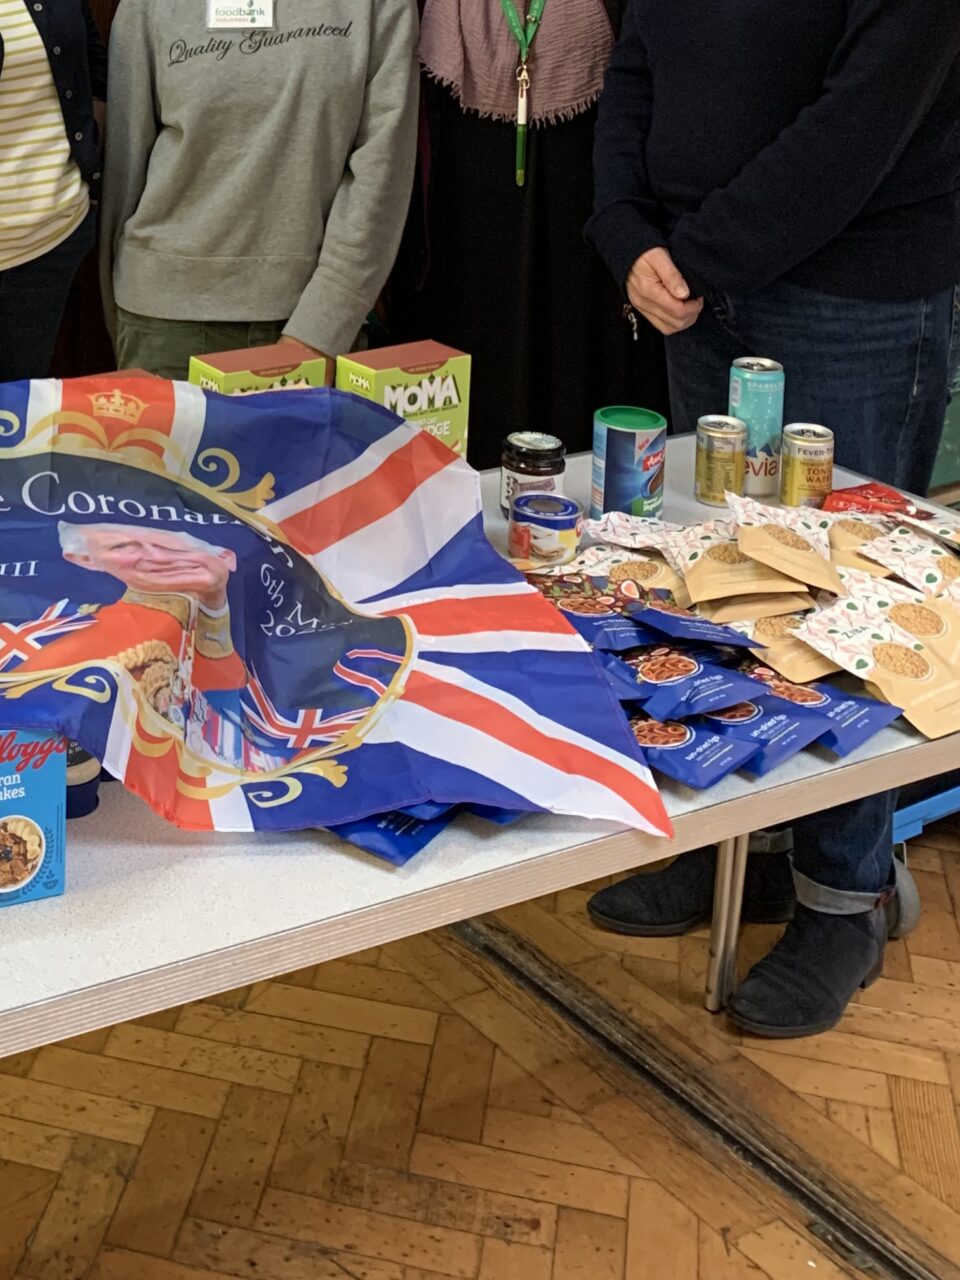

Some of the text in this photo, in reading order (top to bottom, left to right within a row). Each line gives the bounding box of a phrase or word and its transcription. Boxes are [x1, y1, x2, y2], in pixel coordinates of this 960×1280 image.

[215, 6, 265, 17] foodbank
[168, 21, 353, 67] Quality Guaranteed
[349, 372, 372, 390] MOMA
[384, 374, 460, 418] MOMA
[260, 563, 285, 608] 6th
[841, 625, 871, 640] ZIBA
